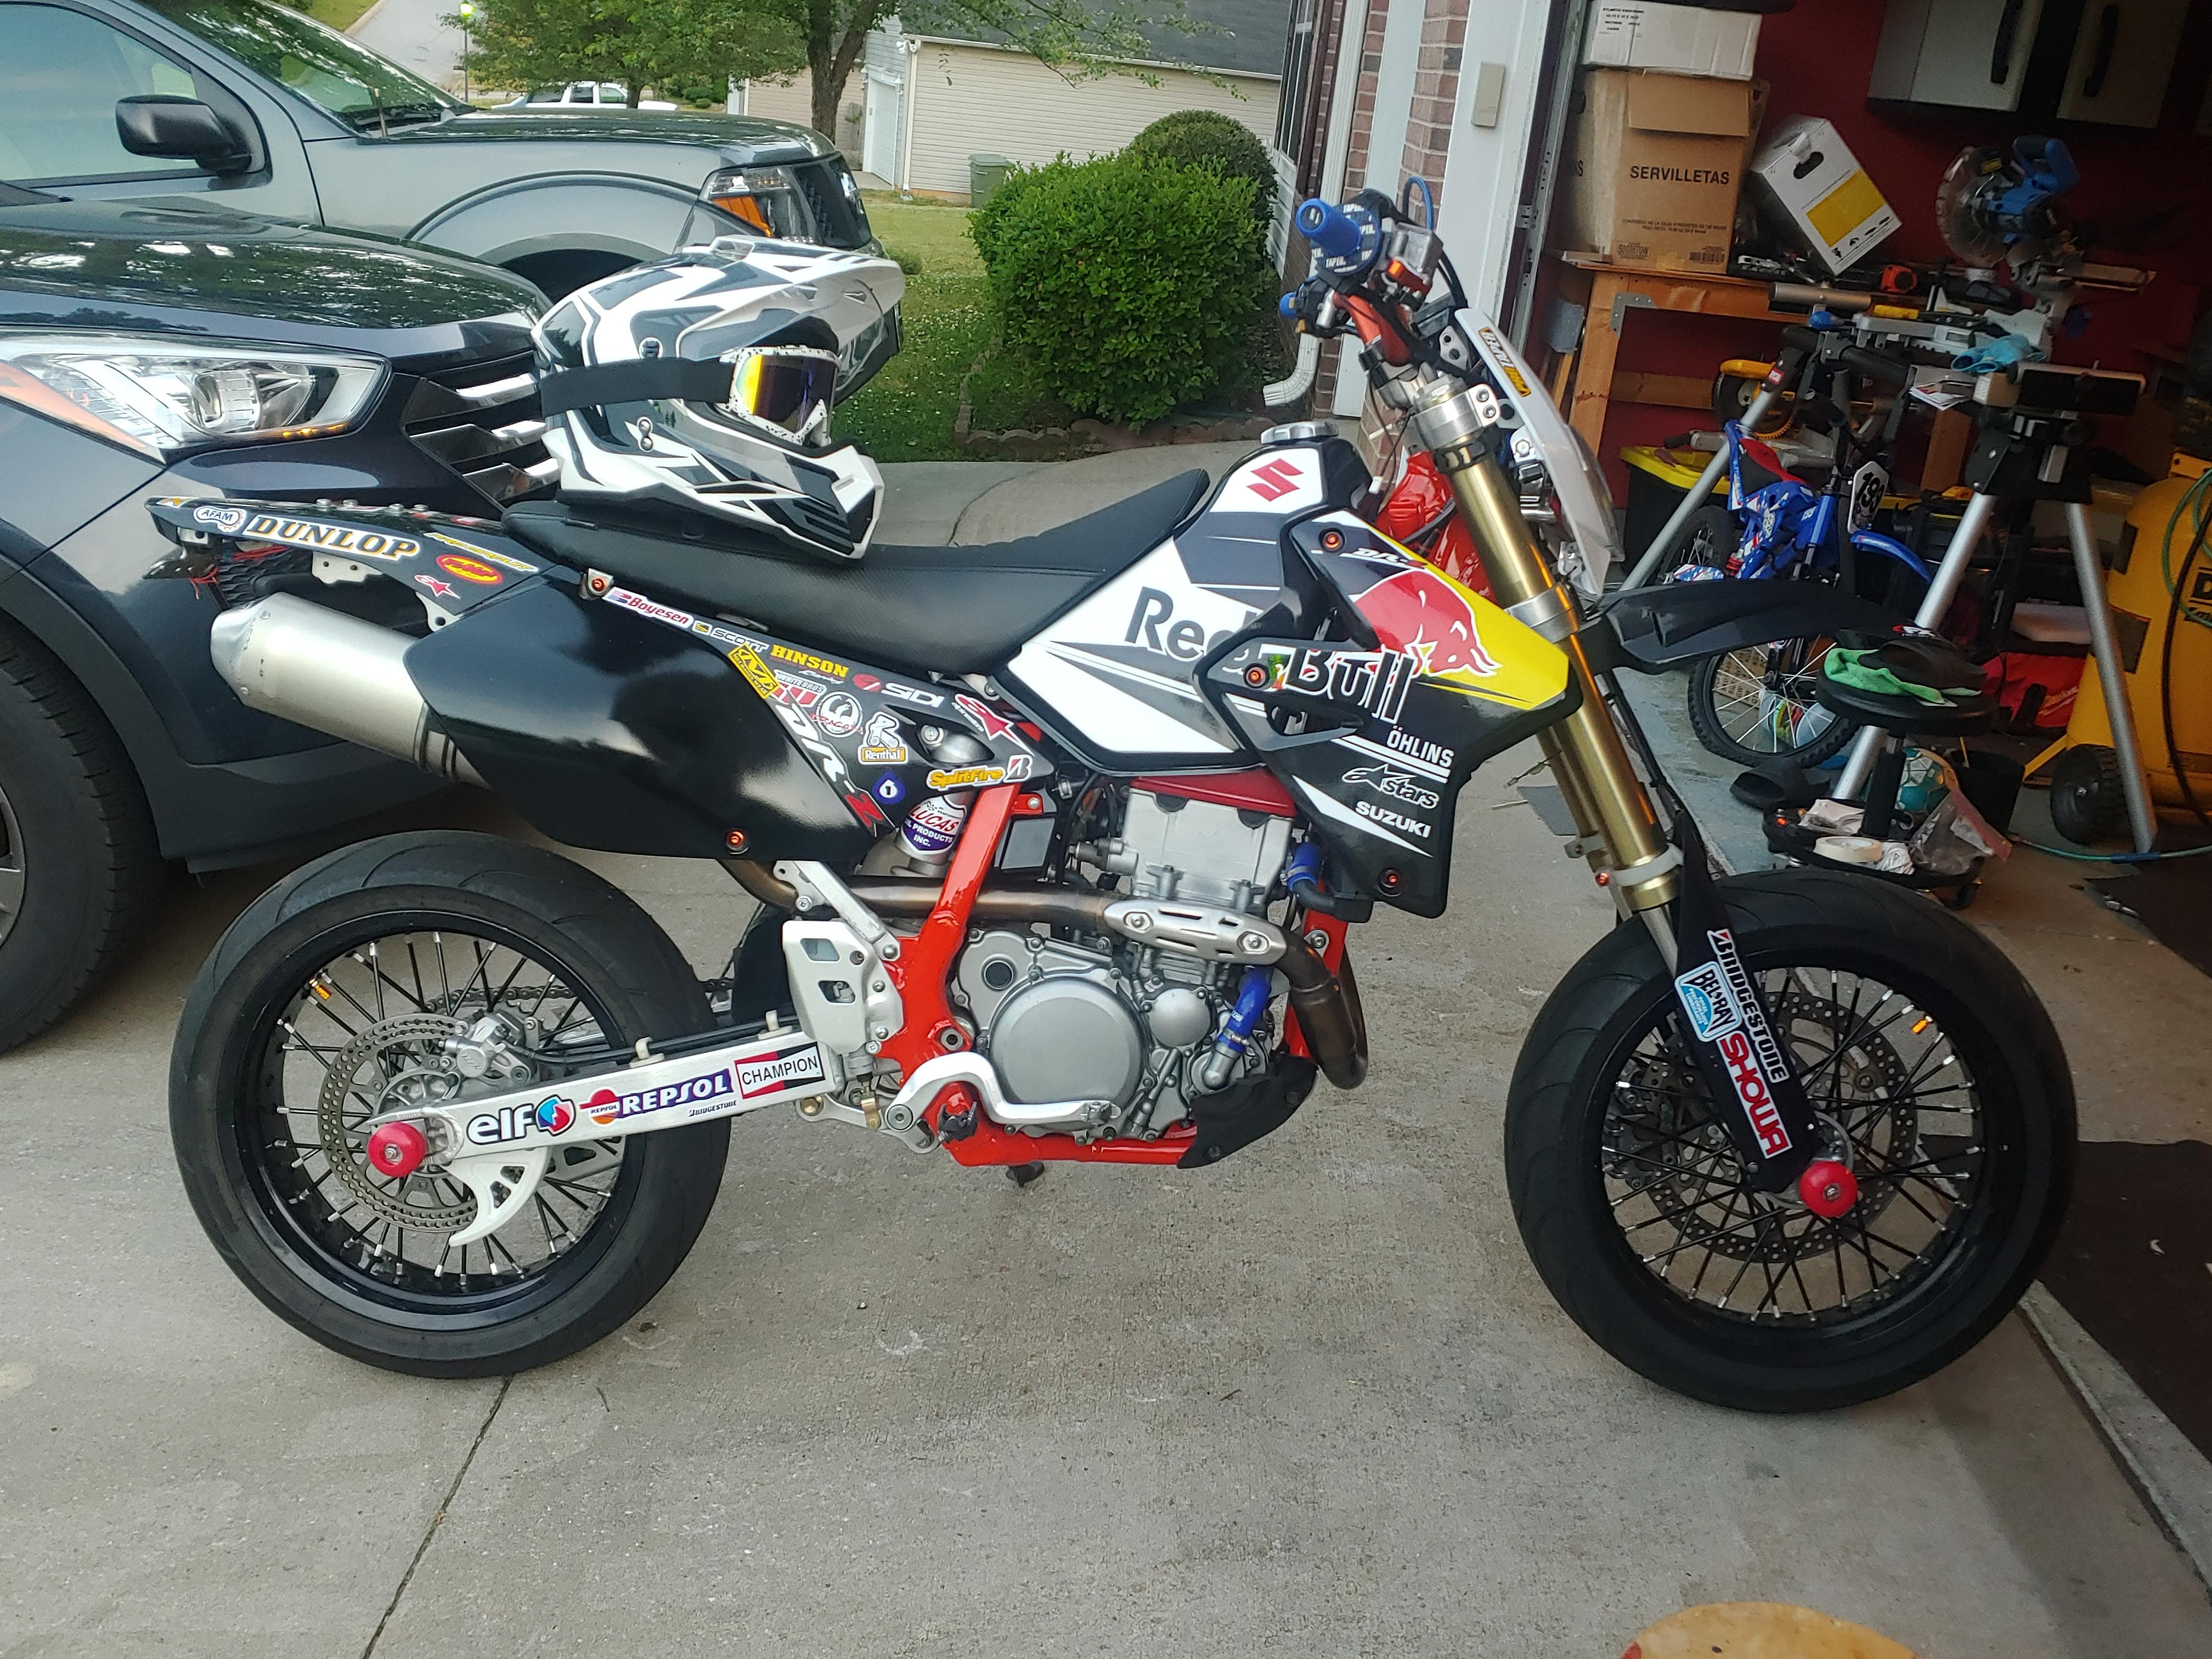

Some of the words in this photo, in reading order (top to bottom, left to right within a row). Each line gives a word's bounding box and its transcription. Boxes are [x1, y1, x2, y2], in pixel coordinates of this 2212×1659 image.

[1630, 165, 1730, 185] SERVILLETAS
[201, 509, 233, 522] AFAM
[246, 516, 419, 561] DUNLOP
[629, 596, 690, 625] Boyesen
[713, 629, 769, 653] SCOTT
[770, 644, 849, 678] HINSON
[777, 673, 802, 686] WHITE
[801, 681, 824, 693] BROS
[881, 682, 945, 708] SIDI
[1284, 648, 1417, 724] Bull
[865, 748, 901, 761] Renthal
[1386, 725, 1455, 768] ÖHLINS
[929, 768, 1003, 789] SplitFire
[910, 806, 960, 832] LUCAS
[1355, 800, 1432, 838] SUZUKI
[912, 823, 953, 843] PRODUCTS
[913, 834, 931, 847] INC.
[1711, 930, 1788, 1082] BRIDGESTONE
[741, 1055, 819, 1086] CHAMPION
[622, 1074, 729, 1115] REPSOL
[1719, 1033, 1790, 1156] SHOWA
[590, 1104, 618, 1115] REPSOL
[688, 1099, 737, 1118] BRIDGESTONE
[467, 1103, 533, 1145] elf
